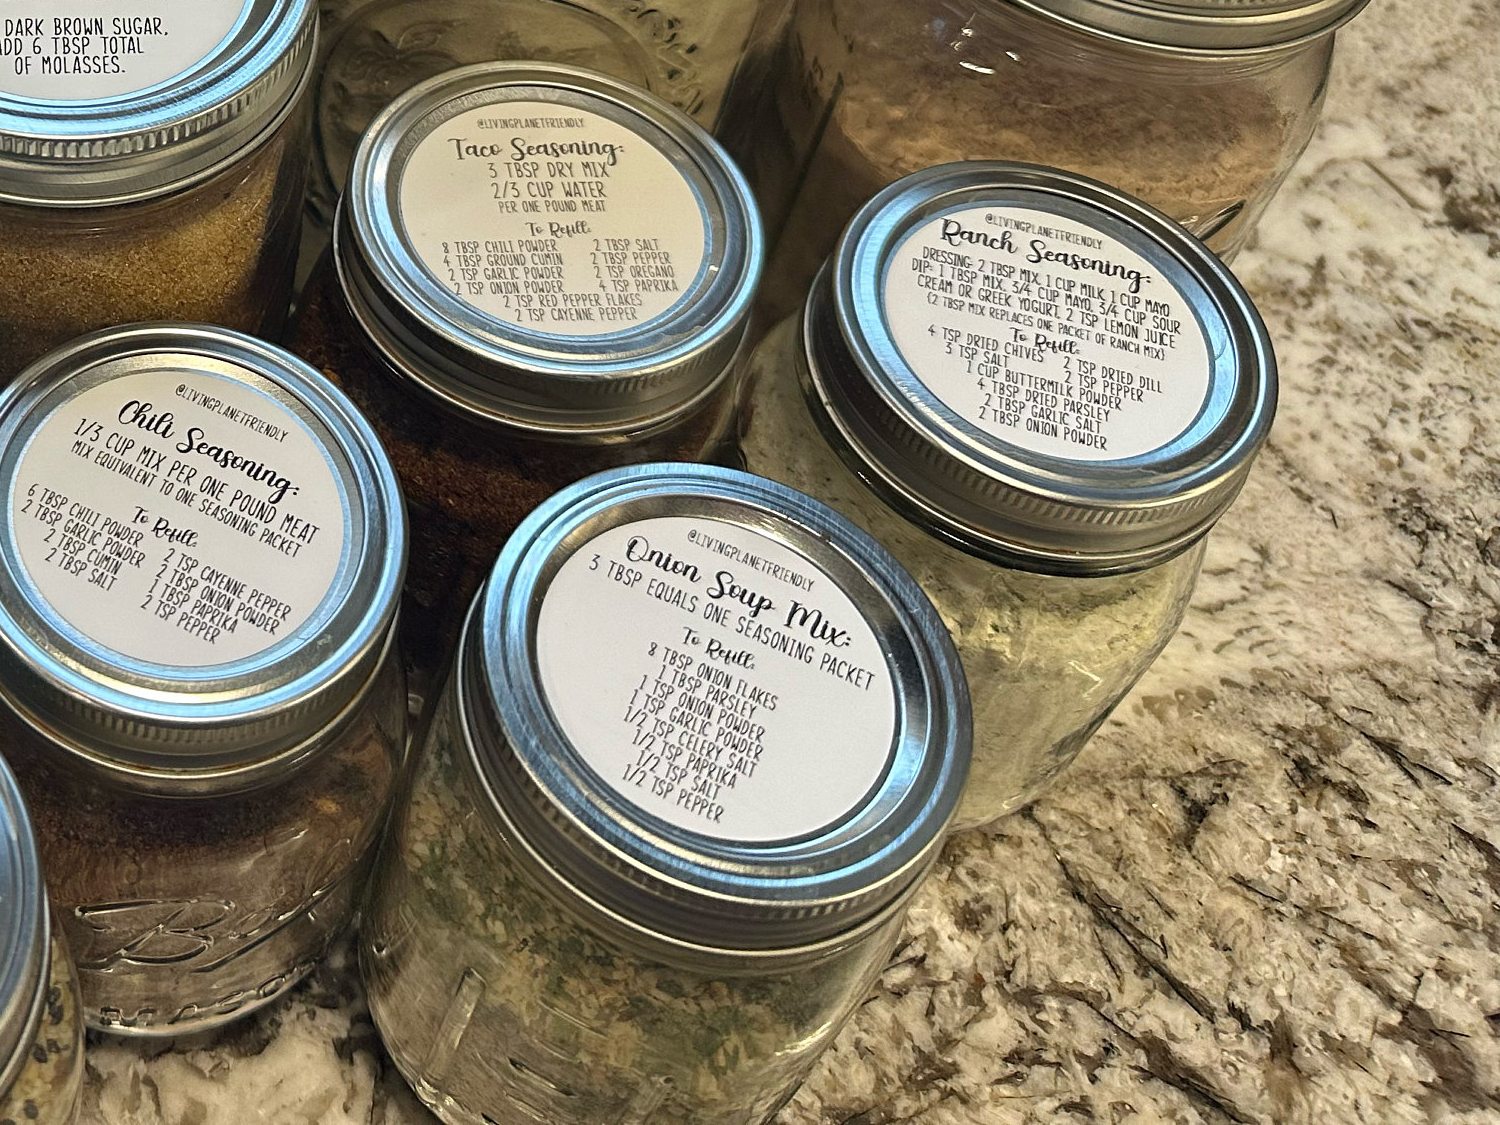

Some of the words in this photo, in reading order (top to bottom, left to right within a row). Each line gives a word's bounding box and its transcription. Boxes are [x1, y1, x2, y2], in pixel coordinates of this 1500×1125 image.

[477, 118, 584, 129] @LIVINGPLANETFRIENDLY
[448, 138, 501, 160] Taco
[511, 138, 625, 166] Seasoning:
[488, 163, 498, 178] 3
[504, 163, 539, 178] TBSP
[547, 162, 574, 177] DRY
[582, 162, 609, 178] MIX
[492, 183, 520, 199] 2/3
[527, 183, 554, 198] CUP
[561, 182, 607, 198] WATER
[940, 217, 1018, 254] Ranch
[1026, 240, 1151, 293] Seasoning:
[985, 213, 1102, 250] @LIVINGPLANETFRIENDLY
[175, 384, 288, 443] @LIVINGPLANETFRIENDLY
[978, 406, 988, 419] 2
[992, 409, 1019, 426] TBSP
[1026, 418, 1058, 437] ONION
[1063, 429, 1108, 451] POWDER
[118, 399, 176, 439] Chili
[176, 427, 299, 505] Seasoning:
[687, 529, 815, 593] @LIVINGPLANETFRIENDLY
[627, 536, 701, 584] Onion
[706, 571, 775, 617] Soup
[783, 600, 851, 648] Mix:
[141, 595, 152, 609] 2
[154, 599, 175, 621] TSP
[177, 608, 221, 644] PEPPER
[589, 554, 600, 571] 3
[606, 560, 642, 590] TBSP
[646, 578, 699, 614] EQUALS
[704, 601, 729, 627] ONE
[736, 616, 814, 663] SEASONING
[820, 655, 875, 691] PACKET
